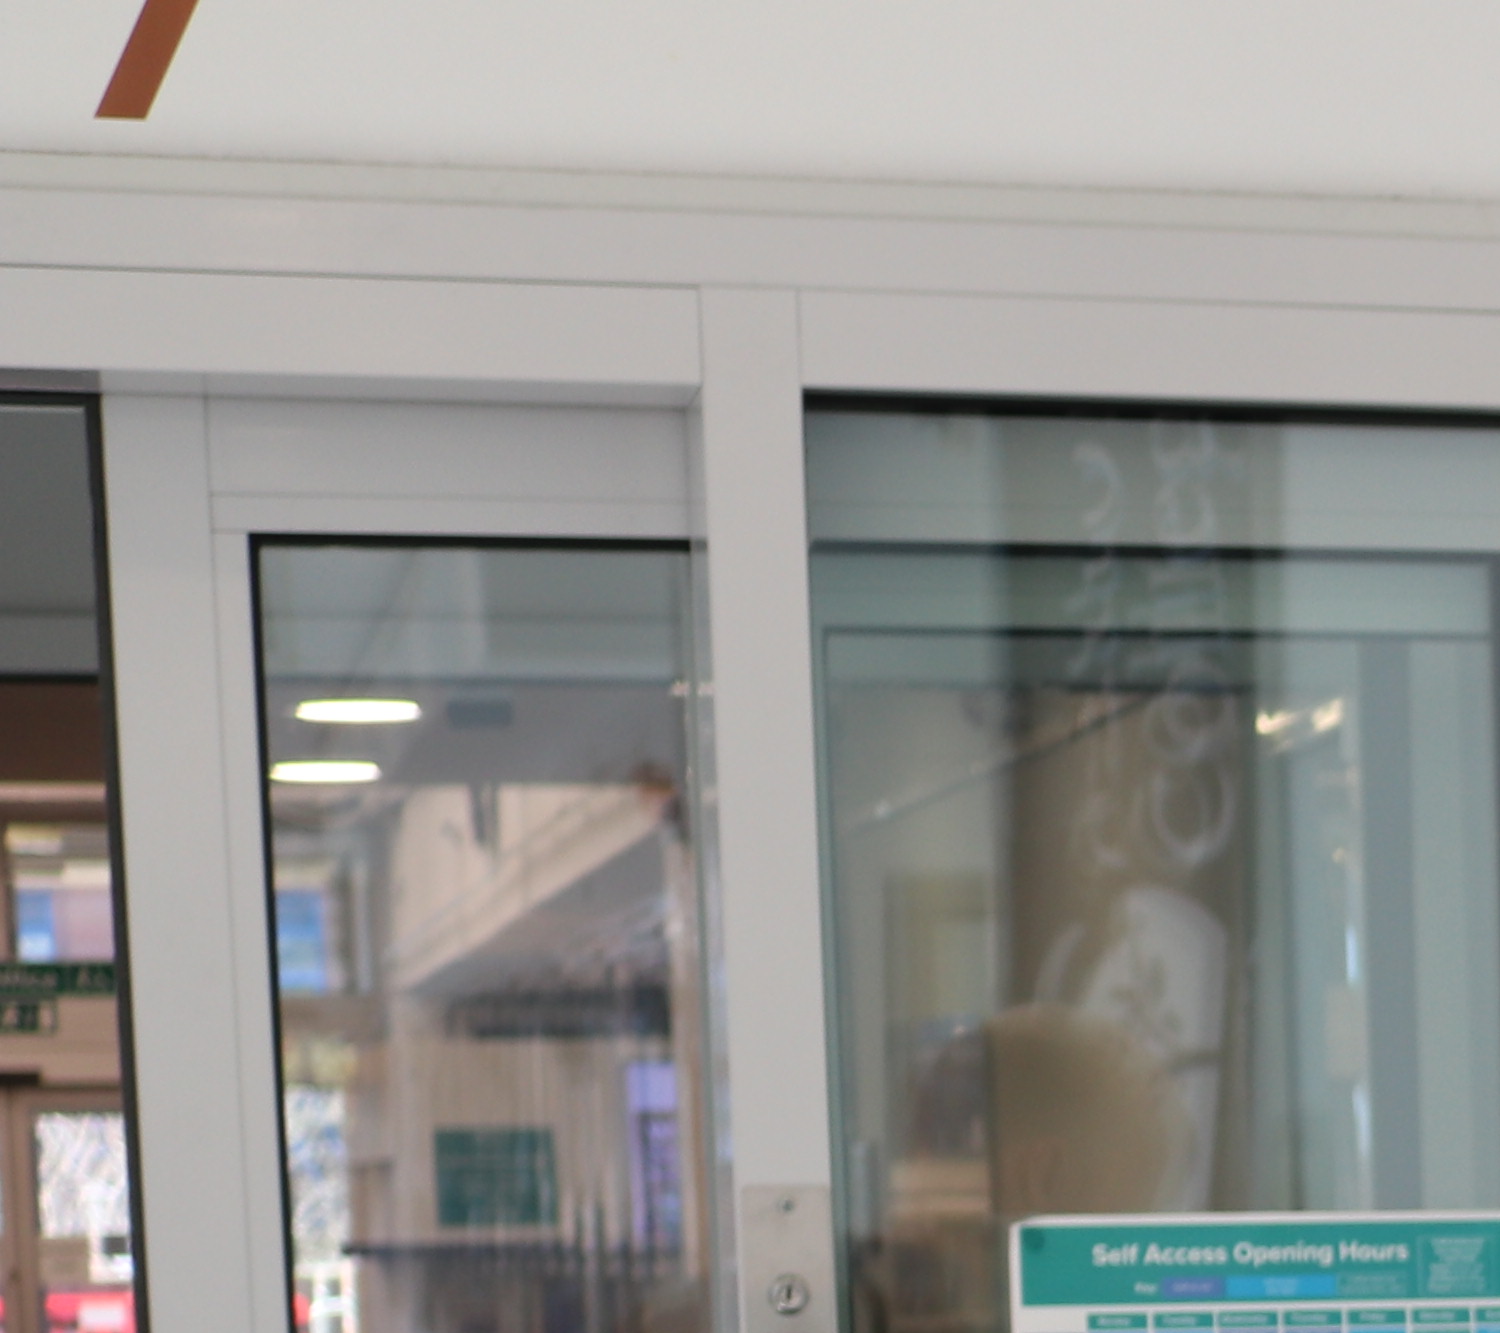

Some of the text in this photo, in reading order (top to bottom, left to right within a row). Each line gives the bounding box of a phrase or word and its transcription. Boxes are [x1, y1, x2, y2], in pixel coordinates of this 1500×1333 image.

[1092, 1240, 1408, 1267] Self Access Opening Hours
